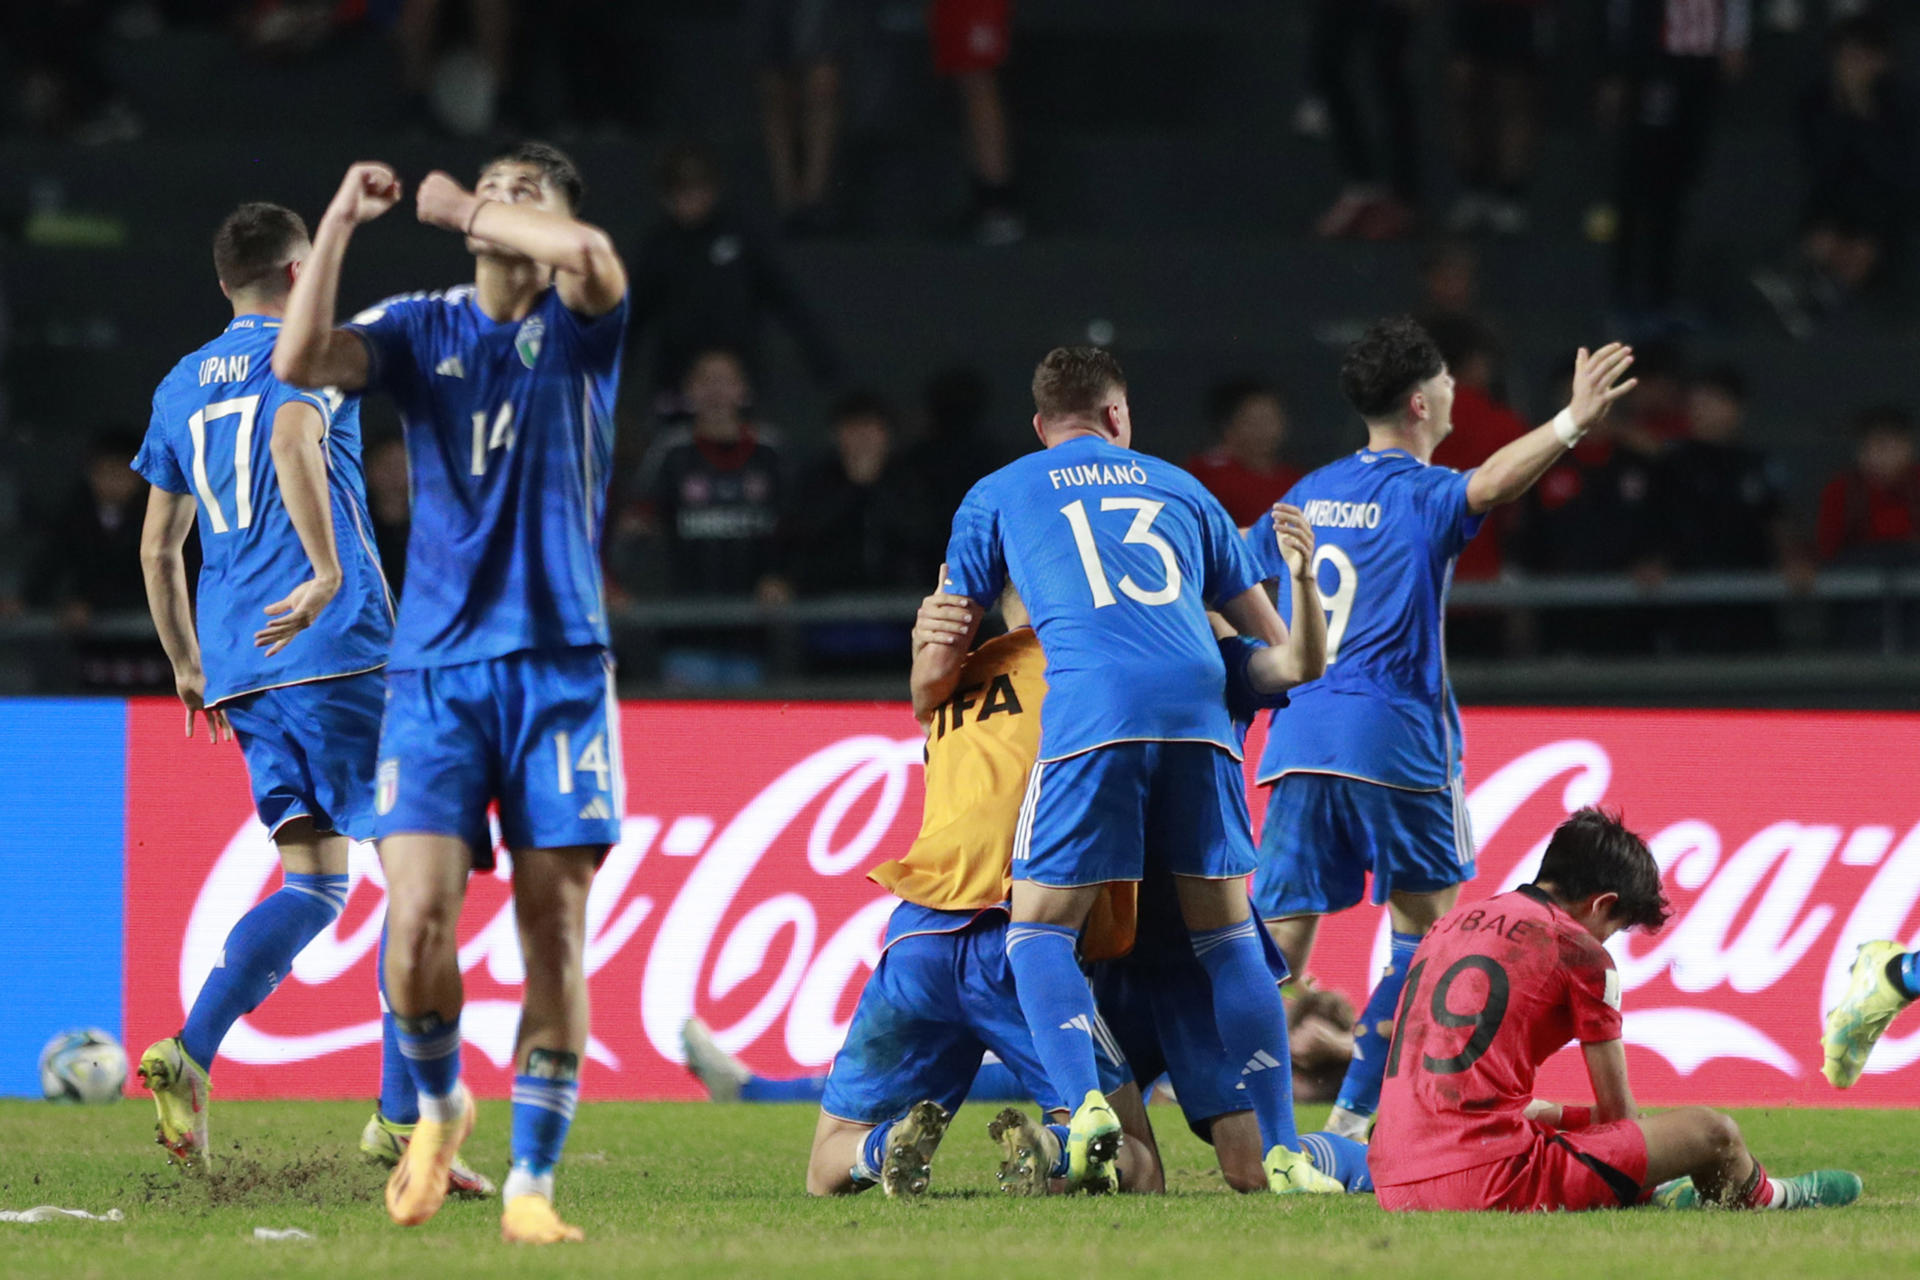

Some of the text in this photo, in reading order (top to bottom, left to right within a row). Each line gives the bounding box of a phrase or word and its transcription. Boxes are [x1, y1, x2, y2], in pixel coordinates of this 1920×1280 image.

[188, 394, 261, 535] 17
[470, 400, 515, 476] 14
[1059, 496, 1182, 609] 13
[1312, 542, 1358, 665] 9
[553, 730, 610, 795] 14
[933, 672, 1023, 741] IFA
[1385, 954, 1510, 1080] 19
